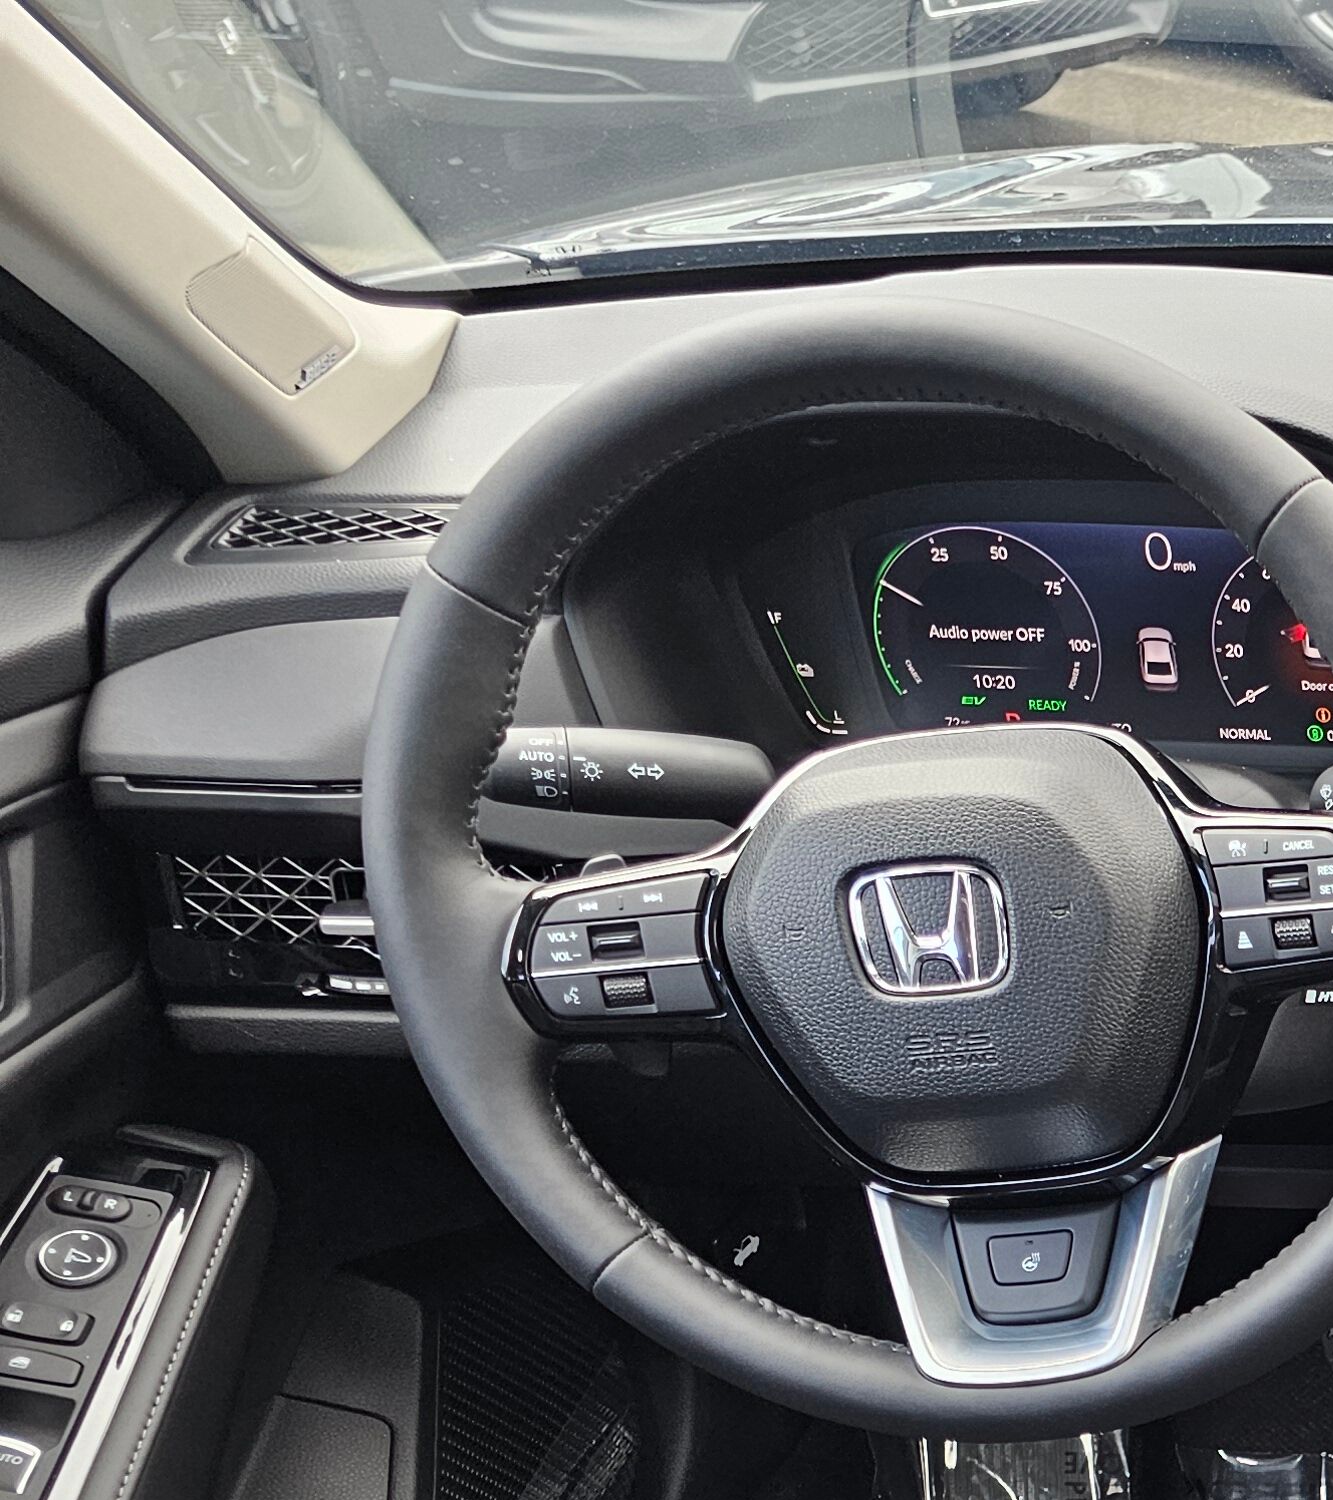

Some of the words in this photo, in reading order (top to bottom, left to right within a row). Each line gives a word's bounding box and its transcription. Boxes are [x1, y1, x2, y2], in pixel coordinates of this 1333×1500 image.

[930, 548, 949, 562] 25
[989, 546, 1008, 561] 50
[1144, 531, 1173, 571] 0
[1173, 561, 1196, 573] mph
[1043, 581, 1063, 596] 75
[1231, 599, 1251, 613] 40
[774, 612, 782, 624] F
[929, 624, 968, 641] Audio
[971, 628, 1013, 644] power
[1015, 627, 1045, 643] OFF
[1068, 638, 1091, 652] 100
[1225, 643, 1244, 658] 20
[972, 674, 1016, 690] 10:20
[1301, 680, 1327, 693] Door
[1028, 699, 1067, 712] READY
[1219, 727, 1272, 741] NORMAL
[519, 750, 555, 763] AUTO
[1282, 839, 1315, 852] CANCEL
[64, 1191, 74, 1202] L
[103, 1198, 118, 1210] R
